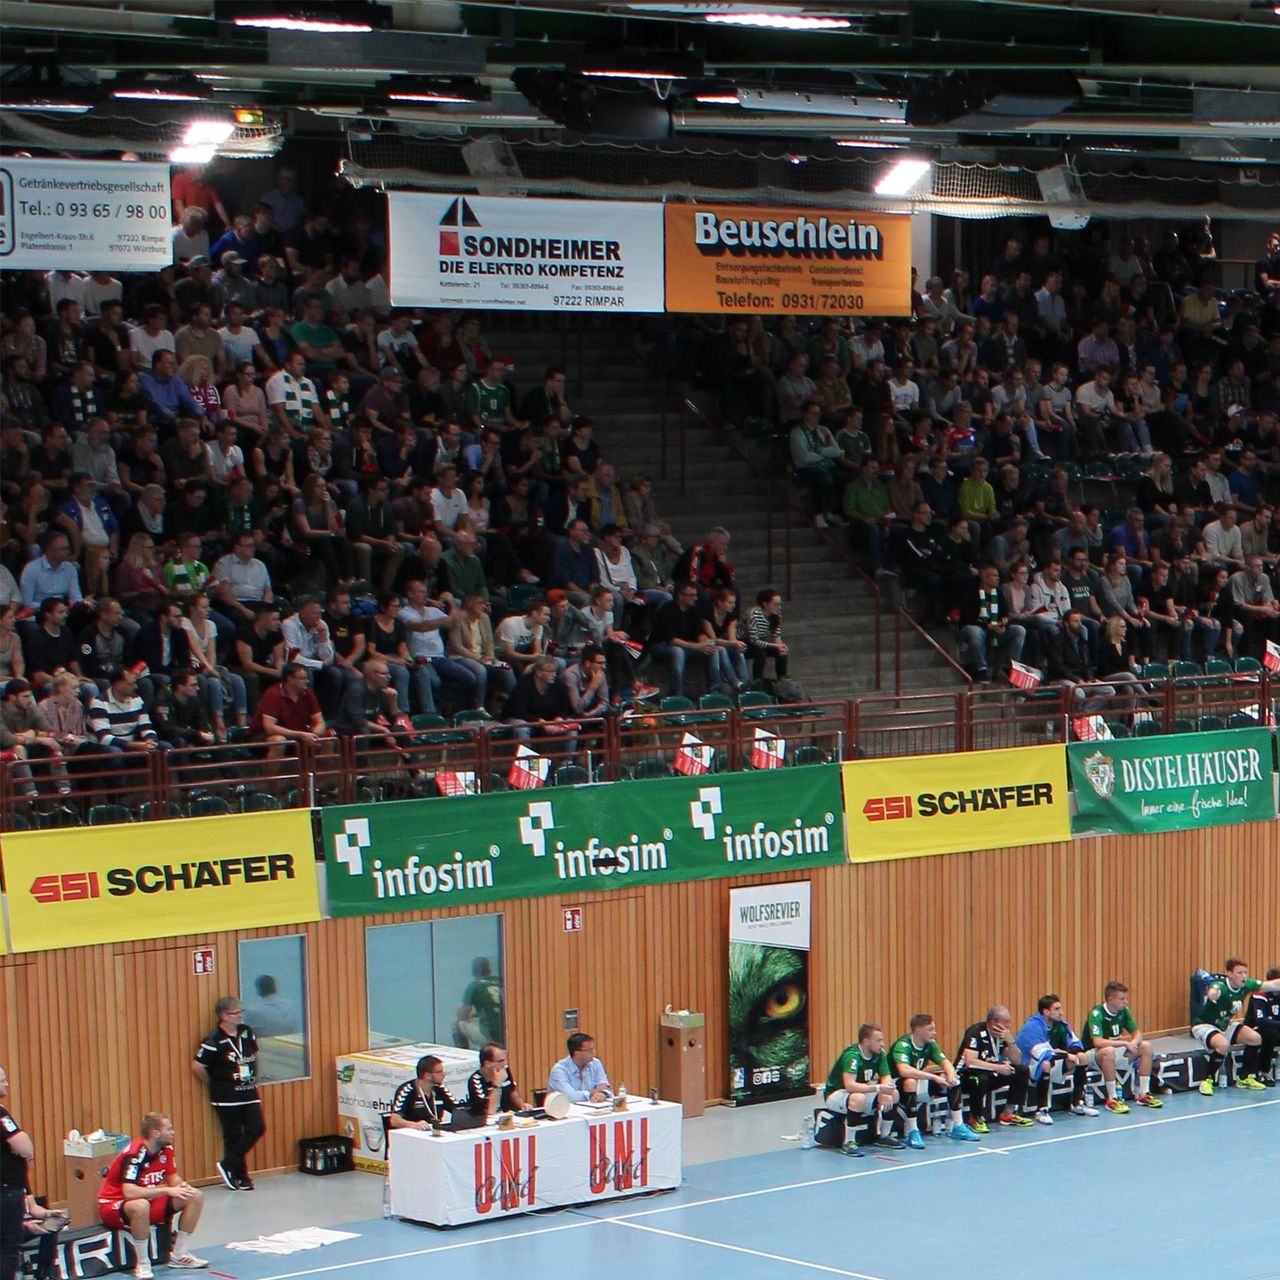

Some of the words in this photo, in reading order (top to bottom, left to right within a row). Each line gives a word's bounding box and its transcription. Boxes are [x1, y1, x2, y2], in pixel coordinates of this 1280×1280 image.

[19, 177, 166, 194] Getränkevertriebsgesellschaft
[19, 201, 51, 217] Tel.:
[56, 202, 65, 217] 0
[70, 203, 88, 218] 93
[93, 204, 111, 218] 65
[126, 205, 144, 219] 98
[149, 206, 167, 220] 00
[463, 235, 622, 261] SONDHEIMER
[696, 211, 884, 261] Beuschlein
[440, 261, 464, 275] DIE
[469, 262, 534, 277] ELEKTRO
[538, 265, 625, 279] KOMPETENZ
[554, 295, 583, 306] 97222
[586, 296, 625, 307] RIMPAR
[717, 292, 774, 308] Telefon:
[782, 294, 864, 311] 0931/72030
[1121, 747, 1264, 793] DISTELHÄUSER
[862, 795, 913, 823] SSI
[917, 782, 1054, 818] SCHÄFER
[1167, 802, 1185, 815] eine
[723, 817, 829, 863] infosim
[29, 871, 101, 904] SSI
[107, 852, 297, 898] SCHÄFER
[374, 851, 494, 899] infosim
[740, 901, 801, 924] WOLFSREVIER
